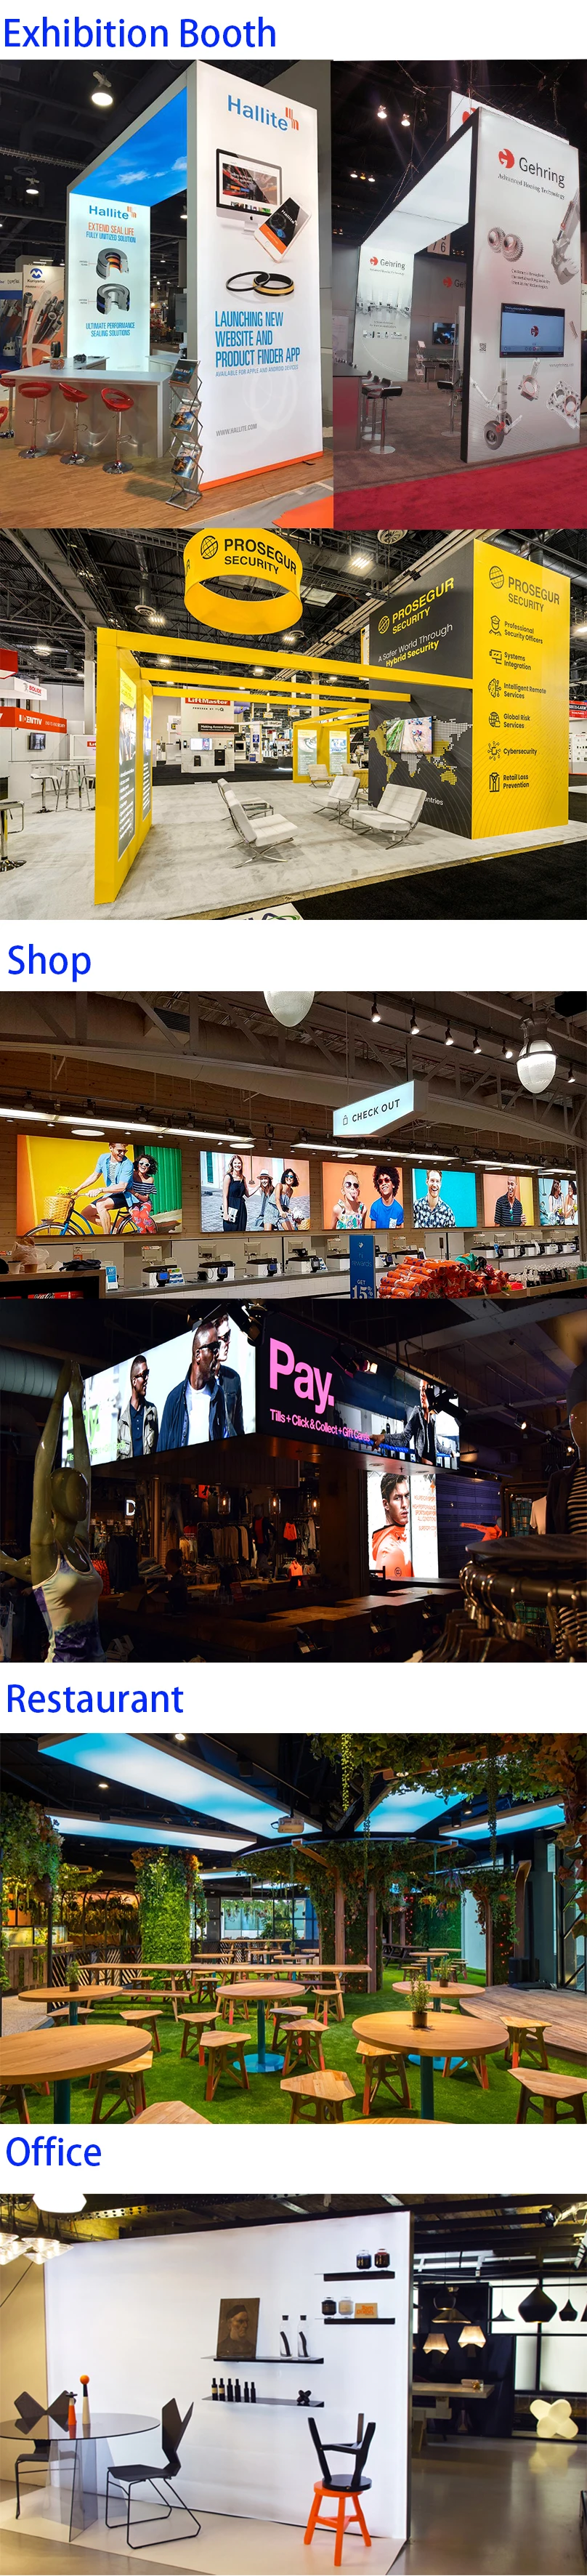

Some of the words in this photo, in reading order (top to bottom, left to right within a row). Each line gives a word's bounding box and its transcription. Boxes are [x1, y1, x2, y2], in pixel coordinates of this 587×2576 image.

[228, 94, 288, 131] Hallite
[519, 157, 564, 188] Gehring
[498, 173, 522, 186] Advanced
[523, 181, 540, 193] Honing
[541, 187, 564, 200] Technology
[89, 205, 129, 219] Hallite
[88, 222, 109, 233] EXTEND
[110, 225, 123, 235] SEAL
[99, 233, 117, 241] UNITIZED
[380, 259, 405, 270] Gehring
[215, 311, 262, 327] LAUNCHING
[265, 312, 283, 326] NEW
[215, 331, 254, 347] WEBSITE
[256, 330, 272, 345] AND
[216, 350, 254, 368] PRODUCT
[257, 348, 283, 365] FINDER
[286, 347, 300, 362] APP
[216, 424, 257, 436] WWW.HALLITE.COM
[224, 538, 296, 575] PROSEGUR
[224, 556, 278, 574] SECURITY
[509, 576, 560, 605] PROSEGUR
[392, 577, 454, 623] PROSEGUR
[509, 593, 544, 612] SECURITY
[392, 607, 431, 634] SECURITY
[504, 621, 534, 634] Professional
[383, 648, 397, 661] Safer
[398, 639, 418, 653] World
[418, 623, 453, 644] Through
[504, 629, 525, 641] Security
[525, 634, 543, 644] Officers
[386, 653, 406, 667] Hybrid
[408, 640, 440, 658] Security
[504, 652, 525, 661] Systems
[504, 660, 532, 671] Integration
[29, 685, 41, 694] BOLIDE
[503, 683, 529, 693] Intelligent
[19, 714, 42, 725] IDENTIV
[352, 1106, 378, 1122] CHECK
[381, 1099, 400, 1113] OUT
[270, 1338, 334, 1414] Pay.
[270, 1408, 286, 1423] Tills
[291, 1414, 309, 1429] Click
[309, 1419, 315, 1429] &
[315, 1420, 338, 1434] Collect
[343, 1426, 355, 1439] Gift
[354, 1430, 371, 1442] Cards
[126, 1499, 136, 1516] D
